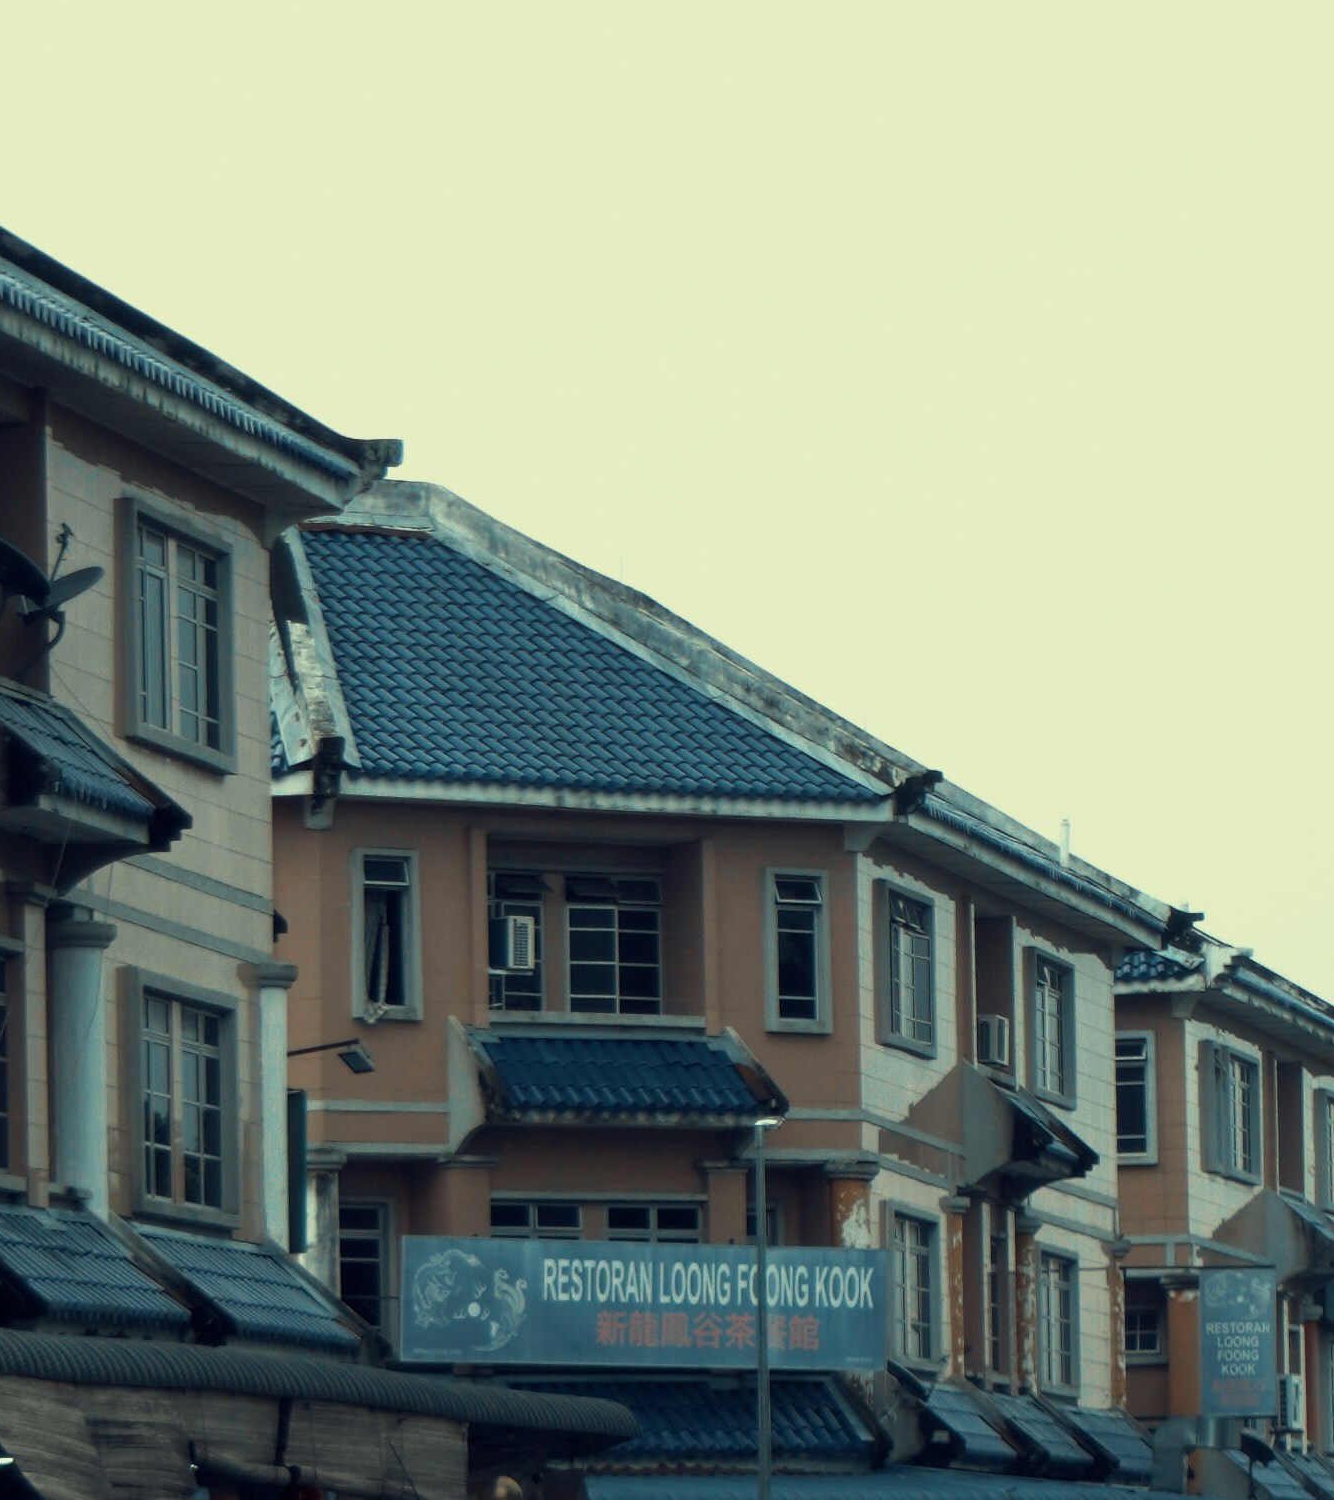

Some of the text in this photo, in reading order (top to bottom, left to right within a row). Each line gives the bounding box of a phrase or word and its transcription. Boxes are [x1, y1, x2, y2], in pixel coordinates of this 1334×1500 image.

[543, 1258, 874, 1309] RESTORAN LOONG FOONG KOOK
[1206, 1322, 1270, 1334] RESTORAN
[1217, 1336, 1260, 1348] LOONG
[1217, 1349, 1260, 1361] FOONG
[1221, 1363, 1256, 1376] KOOK
